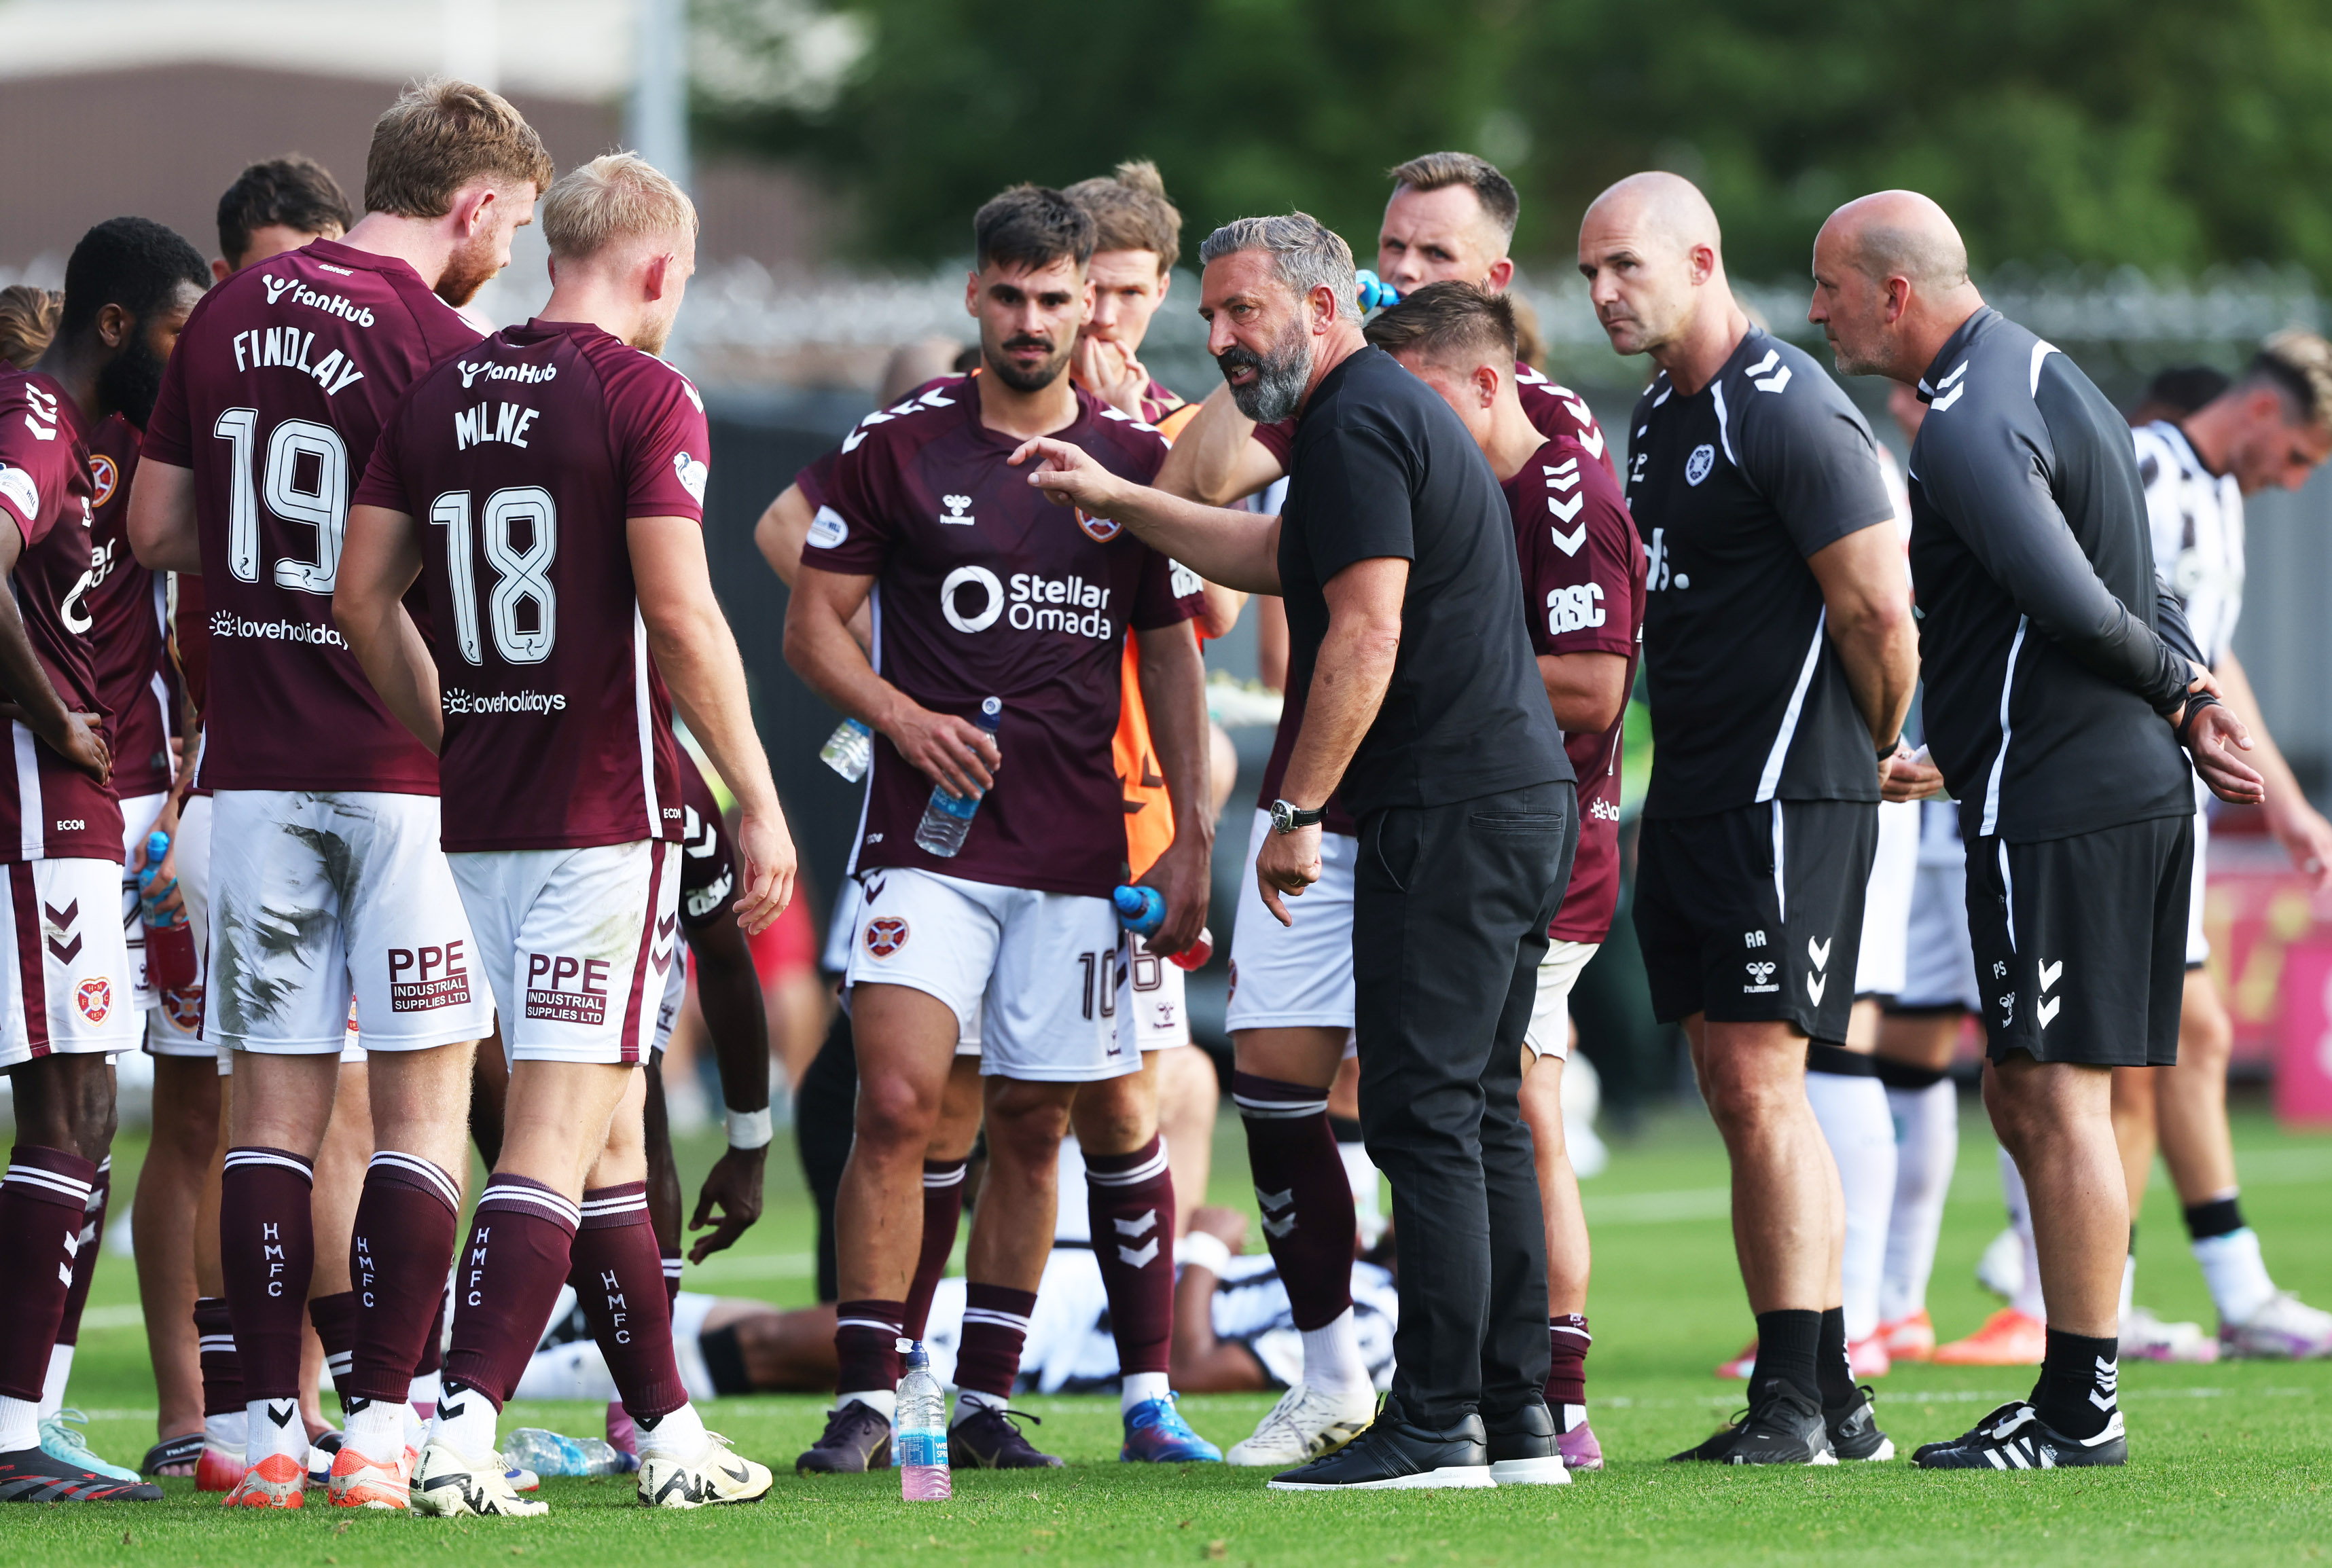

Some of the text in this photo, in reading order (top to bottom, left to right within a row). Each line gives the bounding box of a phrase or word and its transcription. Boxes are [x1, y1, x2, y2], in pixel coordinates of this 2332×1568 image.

[234, 326, 365, 396] FINDLAY
[454, 401, 540, 451] MILNE
[26, 489, 36, 508] HILL
[213, 407, 349, 596] 19
[429, 485, 557, 666] 18
[1009, 573, 1111, 610] Stellar
[1009, 602, 1111, 640] Omada
[1547, 582, 1606, 636] asc
[473, 689, 567, 715] loveholidays
[1744, 930, 1767, 949] AA
[388, 939, 467, 983] PPE
[527, 953, 611, 996] PPE
[1993, 960, 2007, 979] PS
[394, 977, 467, 997] INDUSTRIAL
[395, 992, 468, 1010] SUPPLIES LTD
[528, 991, 603, 1010] INDUSTRIAL
[527, 1006, 603, 1023] SUPPLIES LTD
